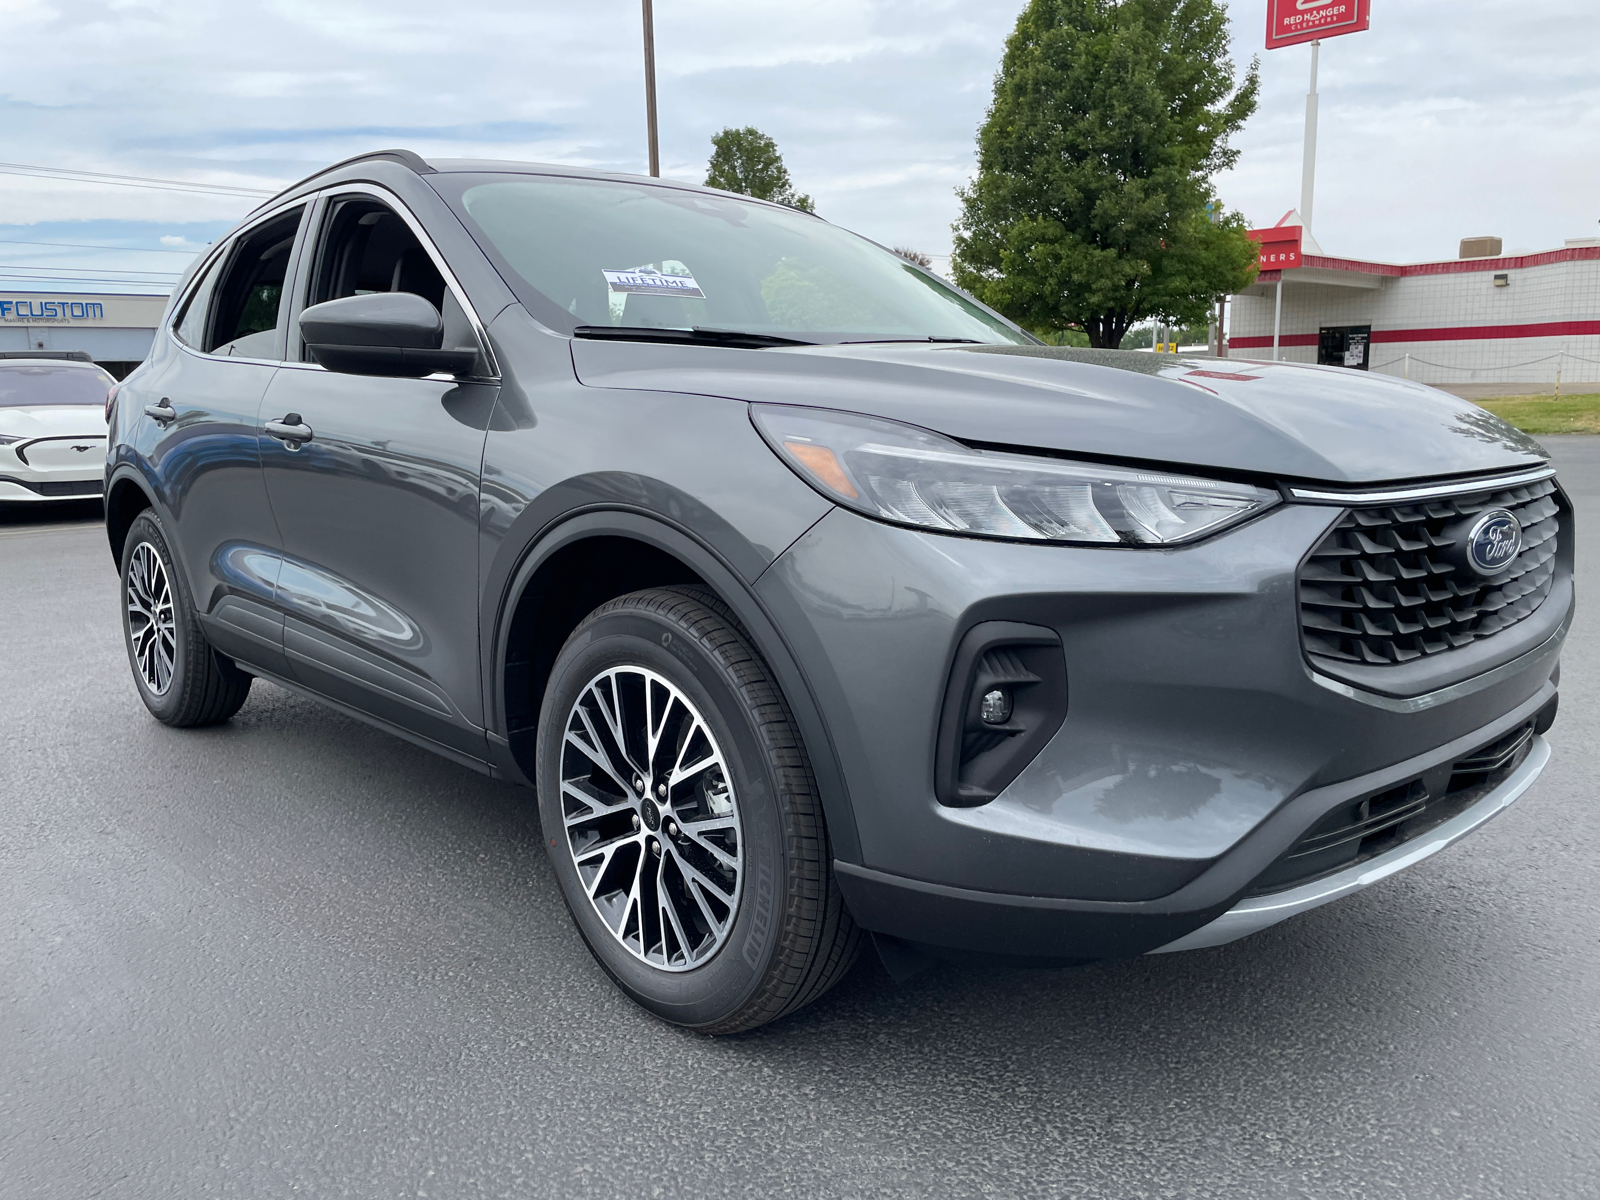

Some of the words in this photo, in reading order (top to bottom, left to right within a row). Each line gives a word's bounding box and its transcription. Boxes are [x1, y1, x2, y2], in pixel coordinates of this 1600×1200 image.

[1284, 15, 1302, 25] RED
[1304, 6, 1346, 20] HANGER
[1291, 16, 1337, 30] CLEANERS
[1260, 252, 1295, 262] NERS
[617, 276, 689, 287] LIFETIME
[1486, 523, 1515, 561] Ford
[746, 842, 772, 962] MICHELIN
